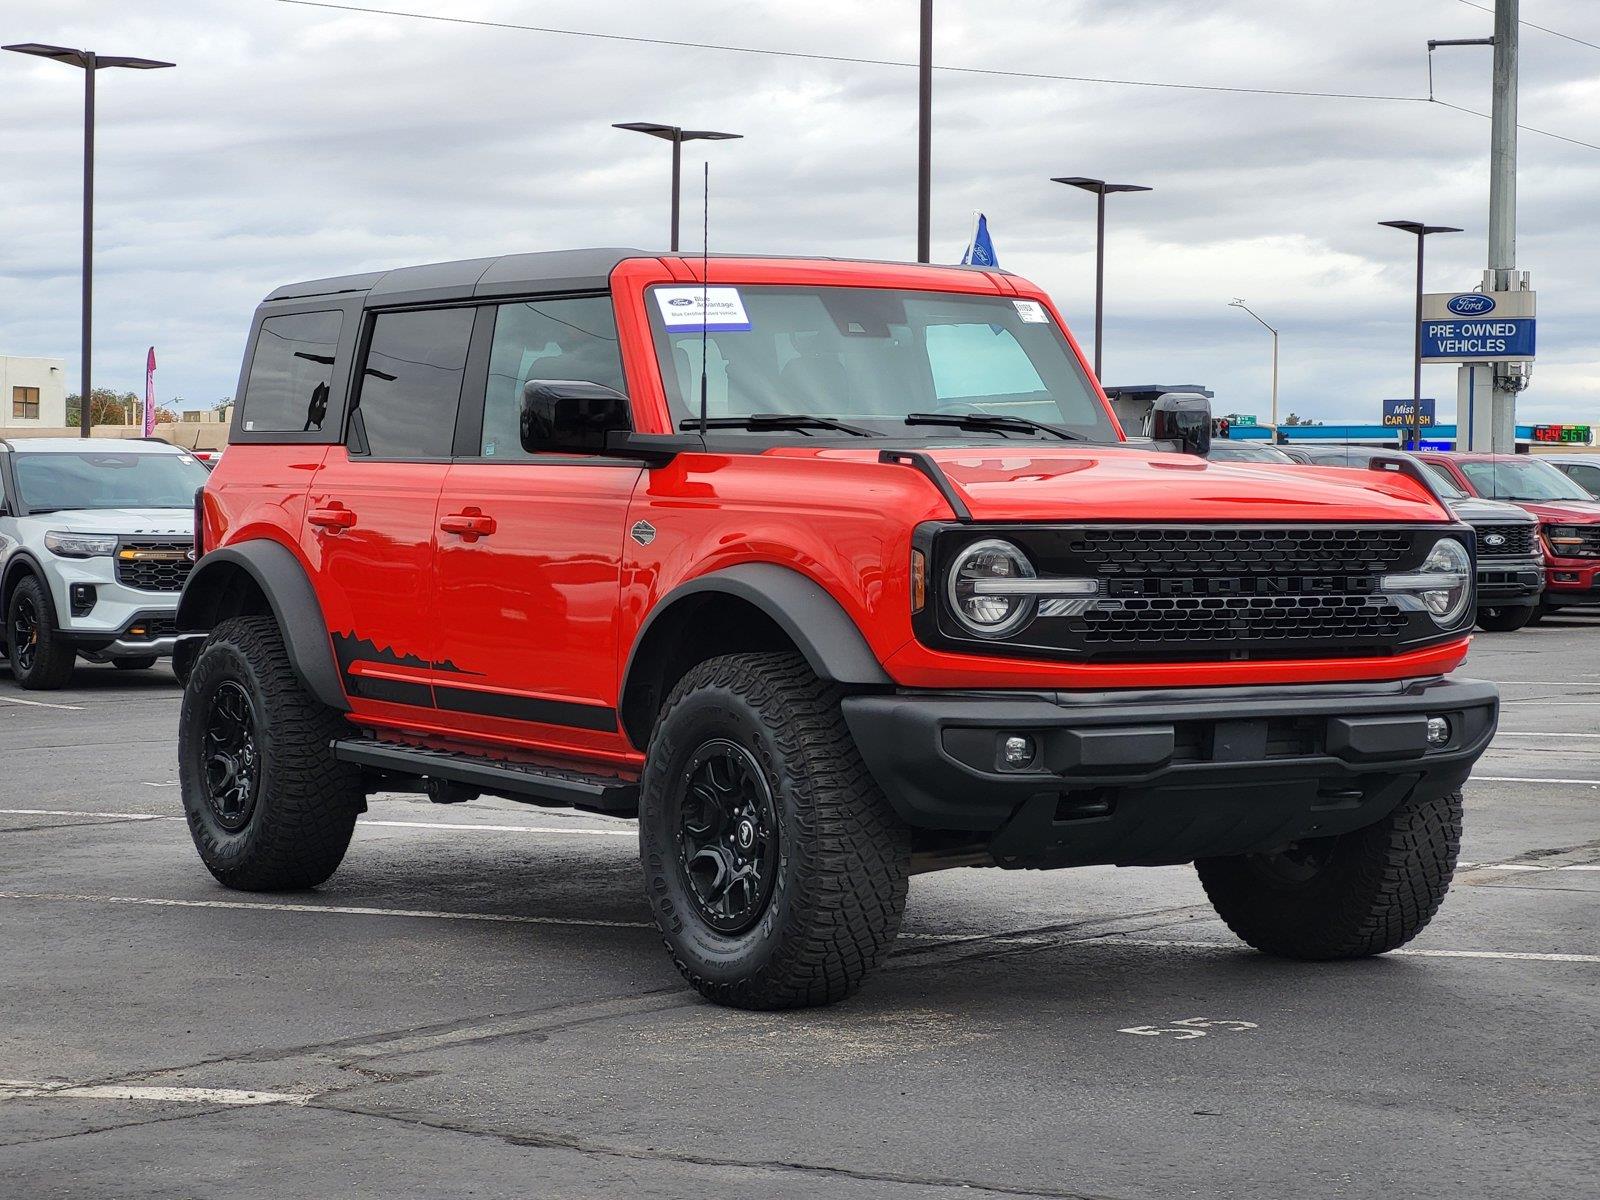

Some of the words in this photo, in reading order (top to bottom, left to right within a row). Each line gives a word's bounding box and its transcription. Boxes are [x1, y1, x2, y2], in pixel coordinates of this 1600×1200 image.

[1437, 339, 1506, 352] VEHICLES
[1393, 404, 1423, 414] Mistr
[1385, 415, 1403, 425] CAR
[1405, 414, 1430, 425] WSH
[1109, 577, 1376, 597] BRONCO
